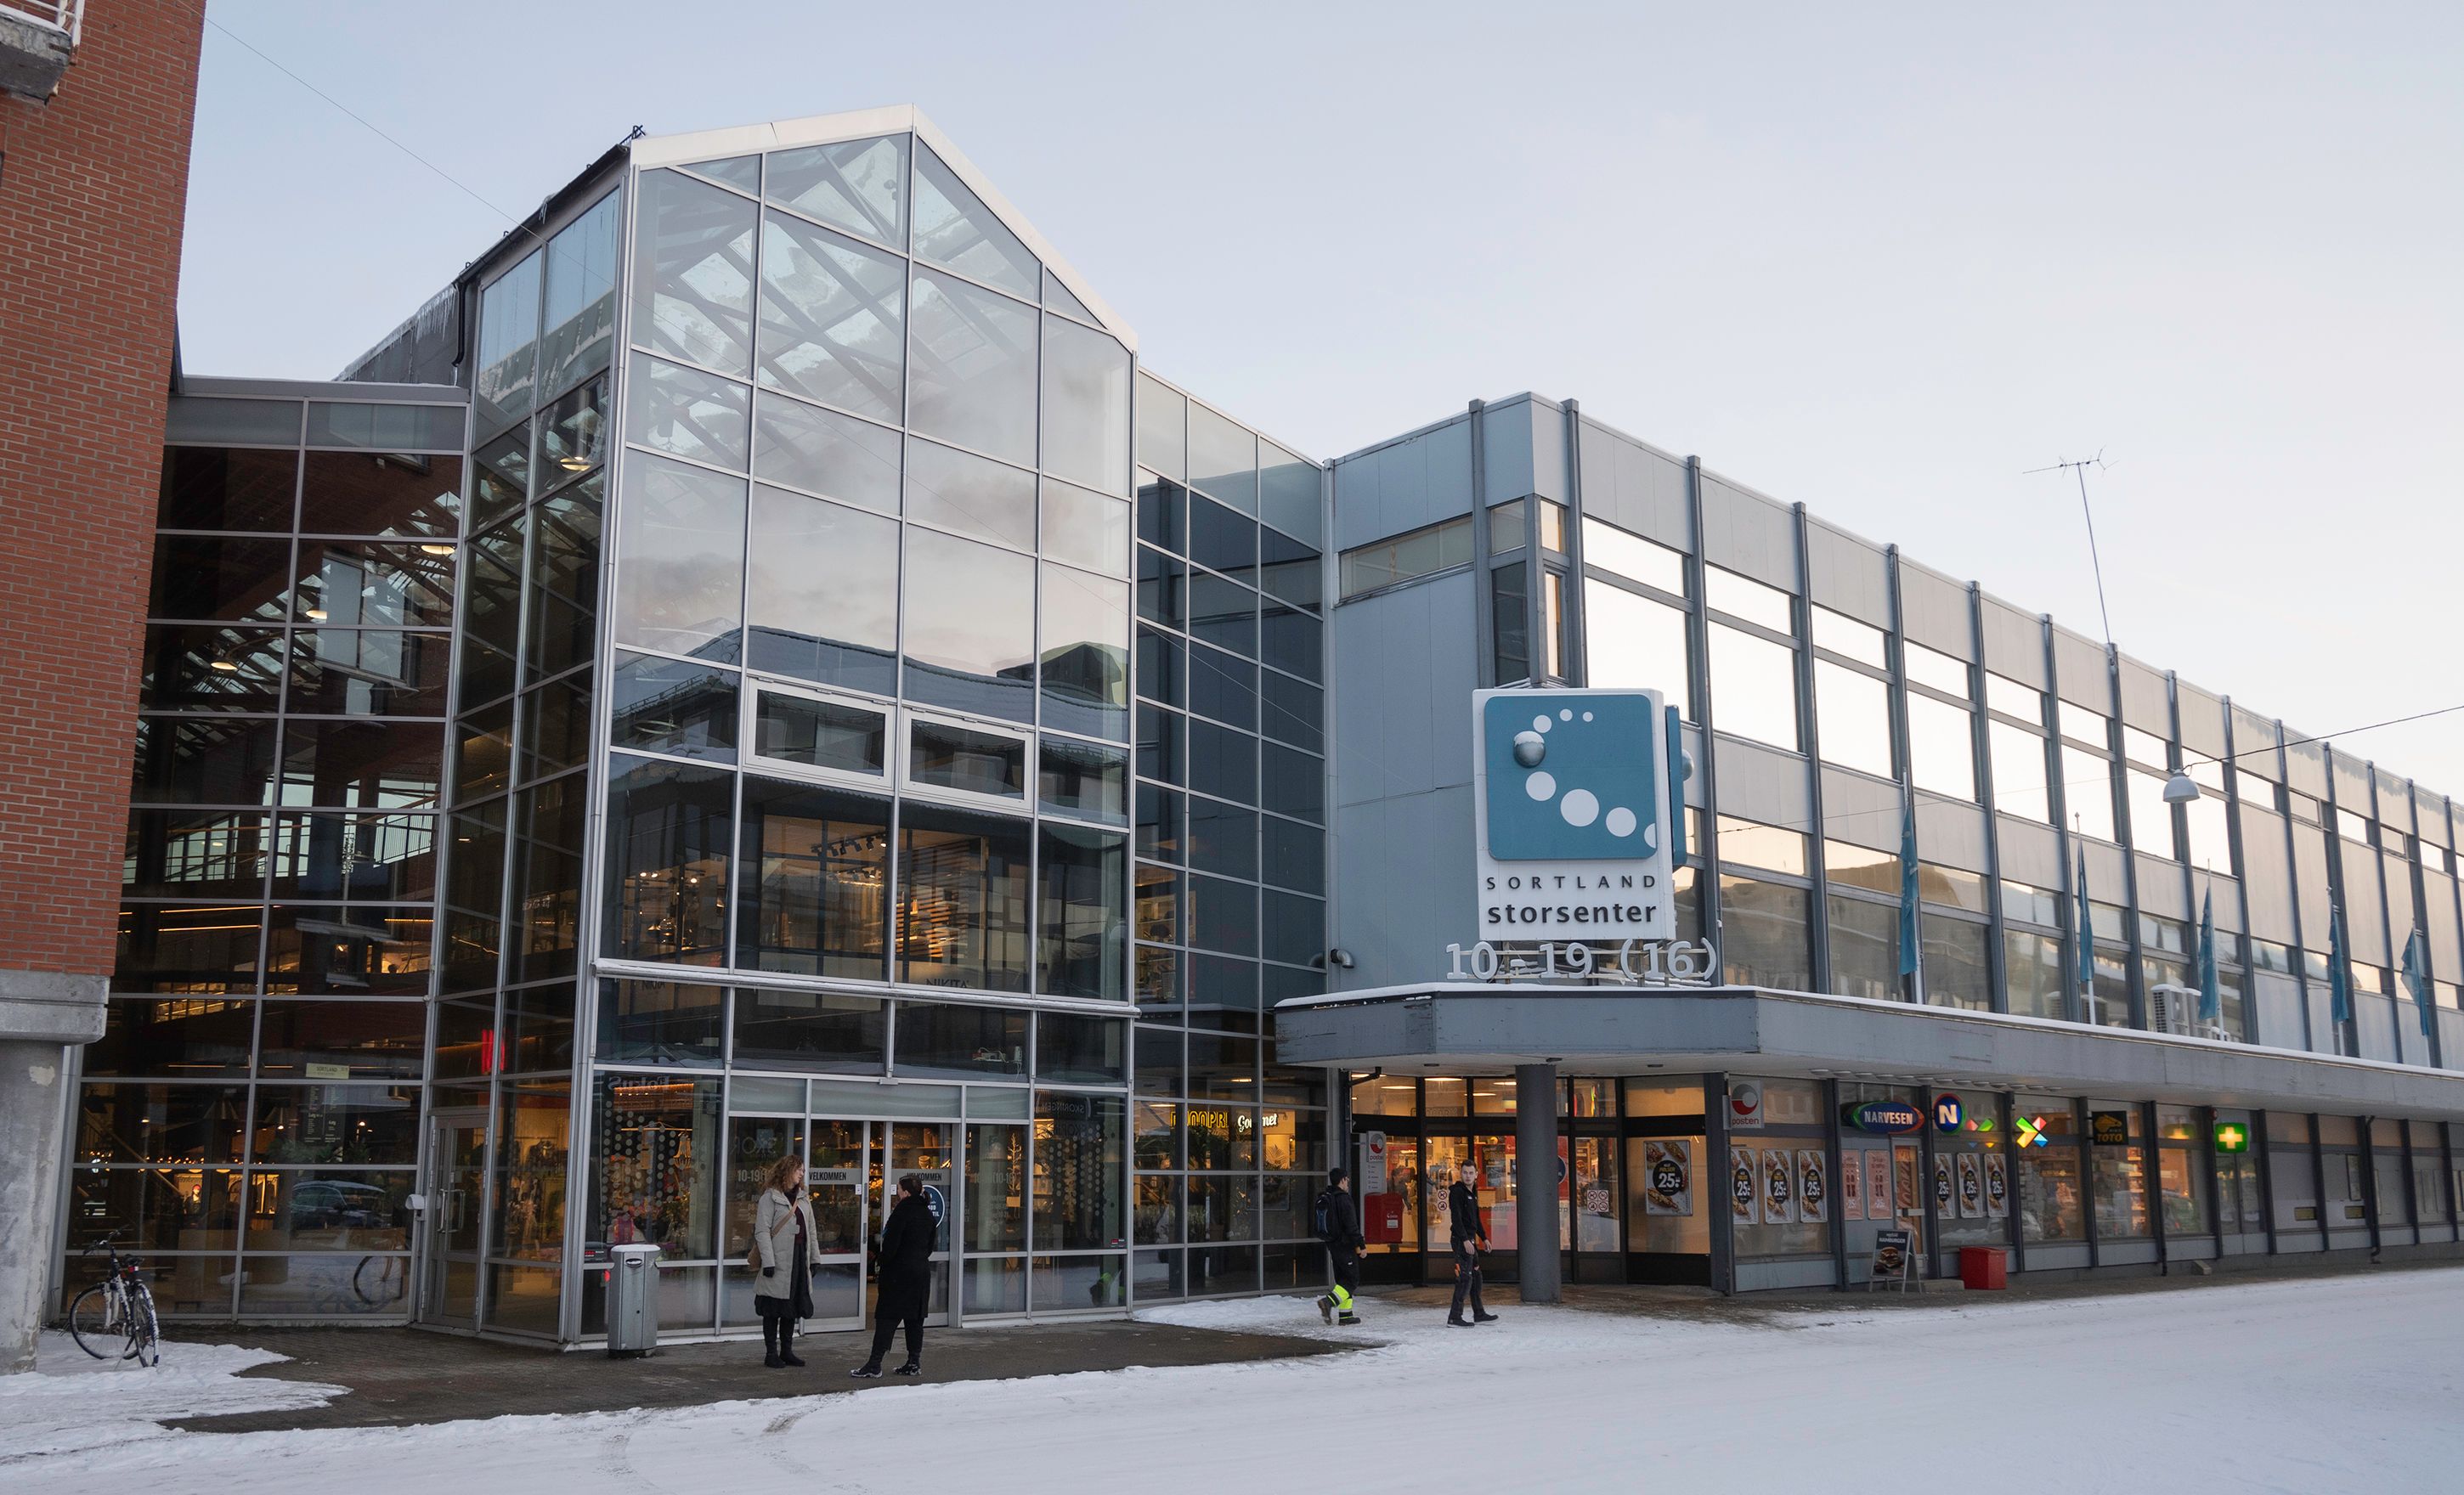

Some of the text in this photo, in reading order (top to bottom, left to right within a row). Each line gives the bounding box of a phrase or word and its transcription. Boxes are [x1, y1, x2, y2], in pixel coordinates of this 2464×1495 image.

[1486, 875, 1656, 890] SORTLAND
[1488, 903, 1657, 924] storsenter
[1619, 937, 1717, 981] (16)
[1864, 1111, 1913, 1125] NARVESEN
[1938, 1104, 1958, 1125] N
[2097, 1133, 2123, 1142] TOTO
[809, 1171, 847, 1181] VELKOMMEN
